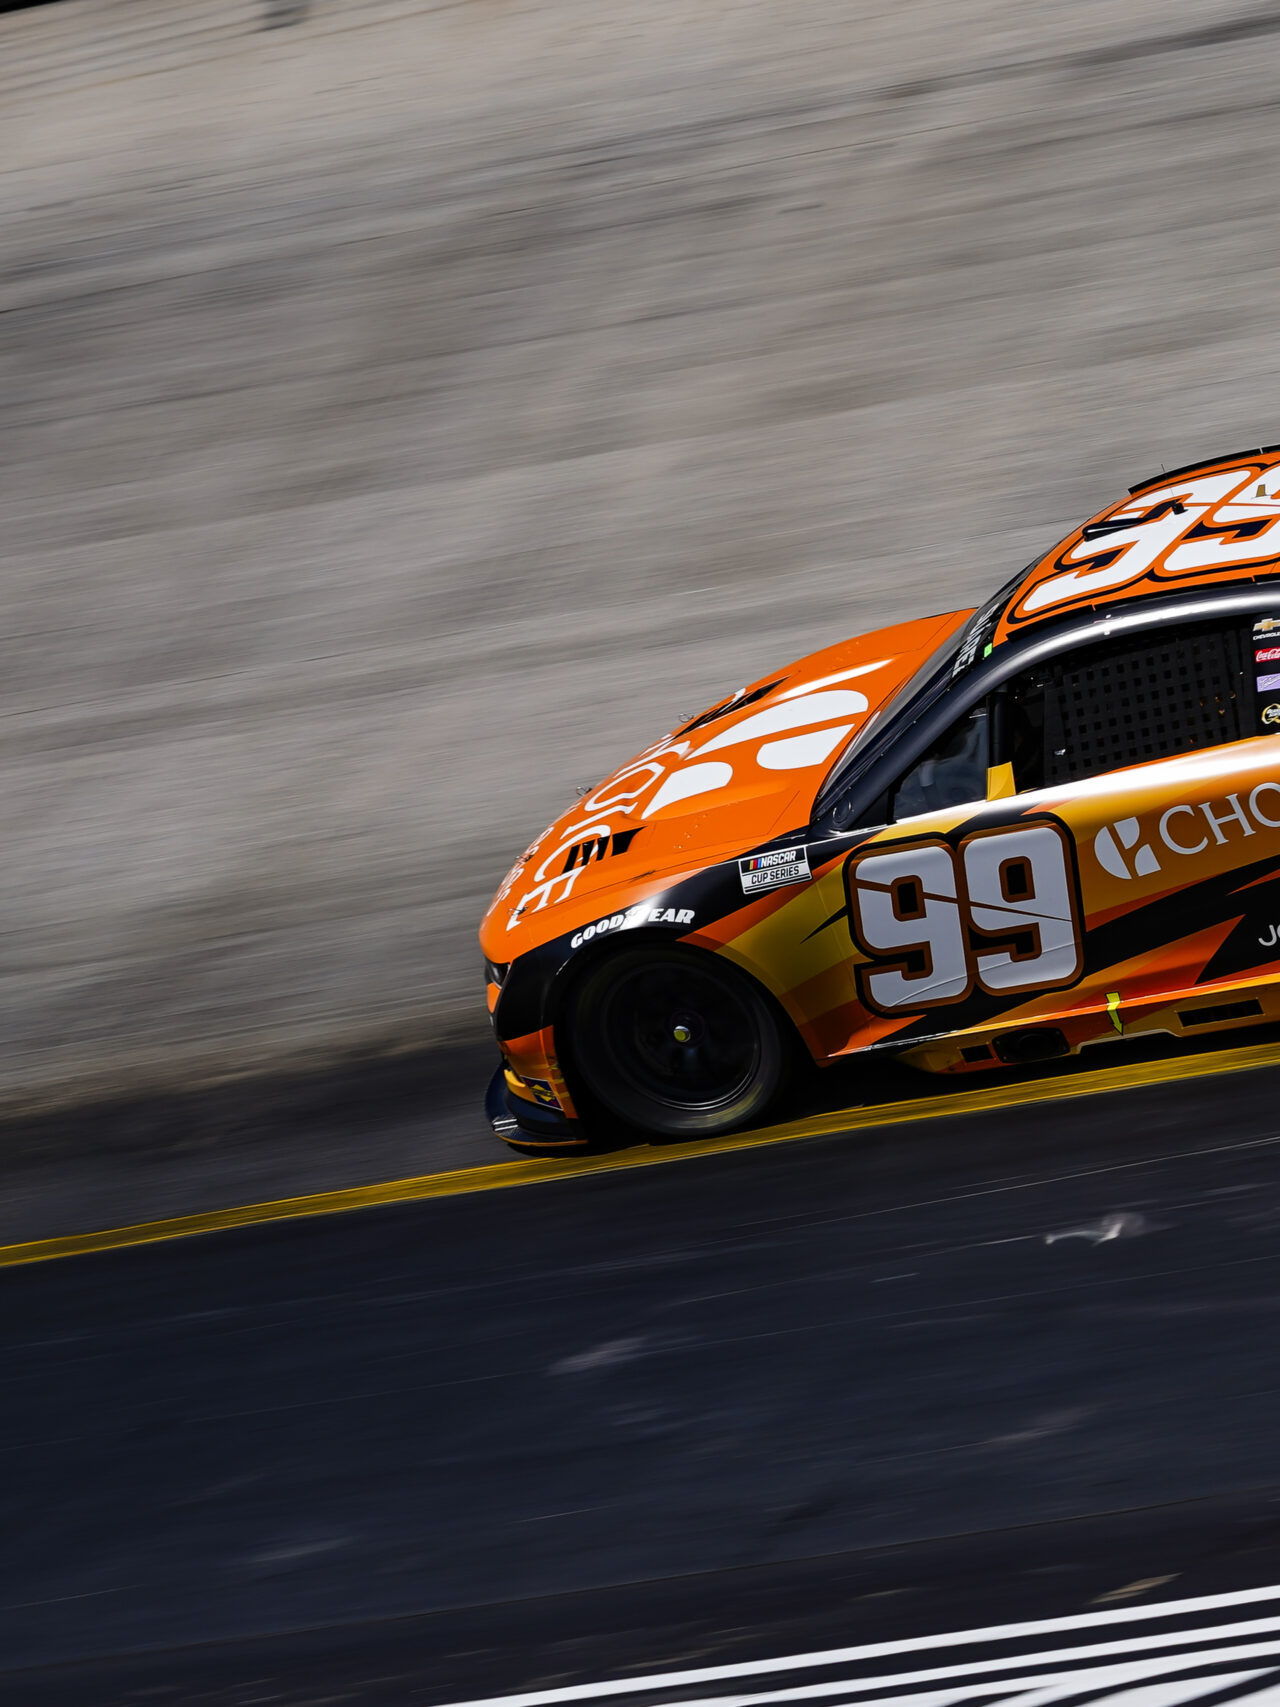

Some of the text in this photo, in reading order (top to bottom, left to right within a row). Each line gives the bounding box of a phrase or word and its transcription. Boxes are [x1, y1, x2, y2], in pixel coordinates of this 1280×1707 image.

[760, 850, 797, 868] NASCAR
[751, 865, 800, 884] CUP SERIES
[855, 827, 1078, 1008] 99
